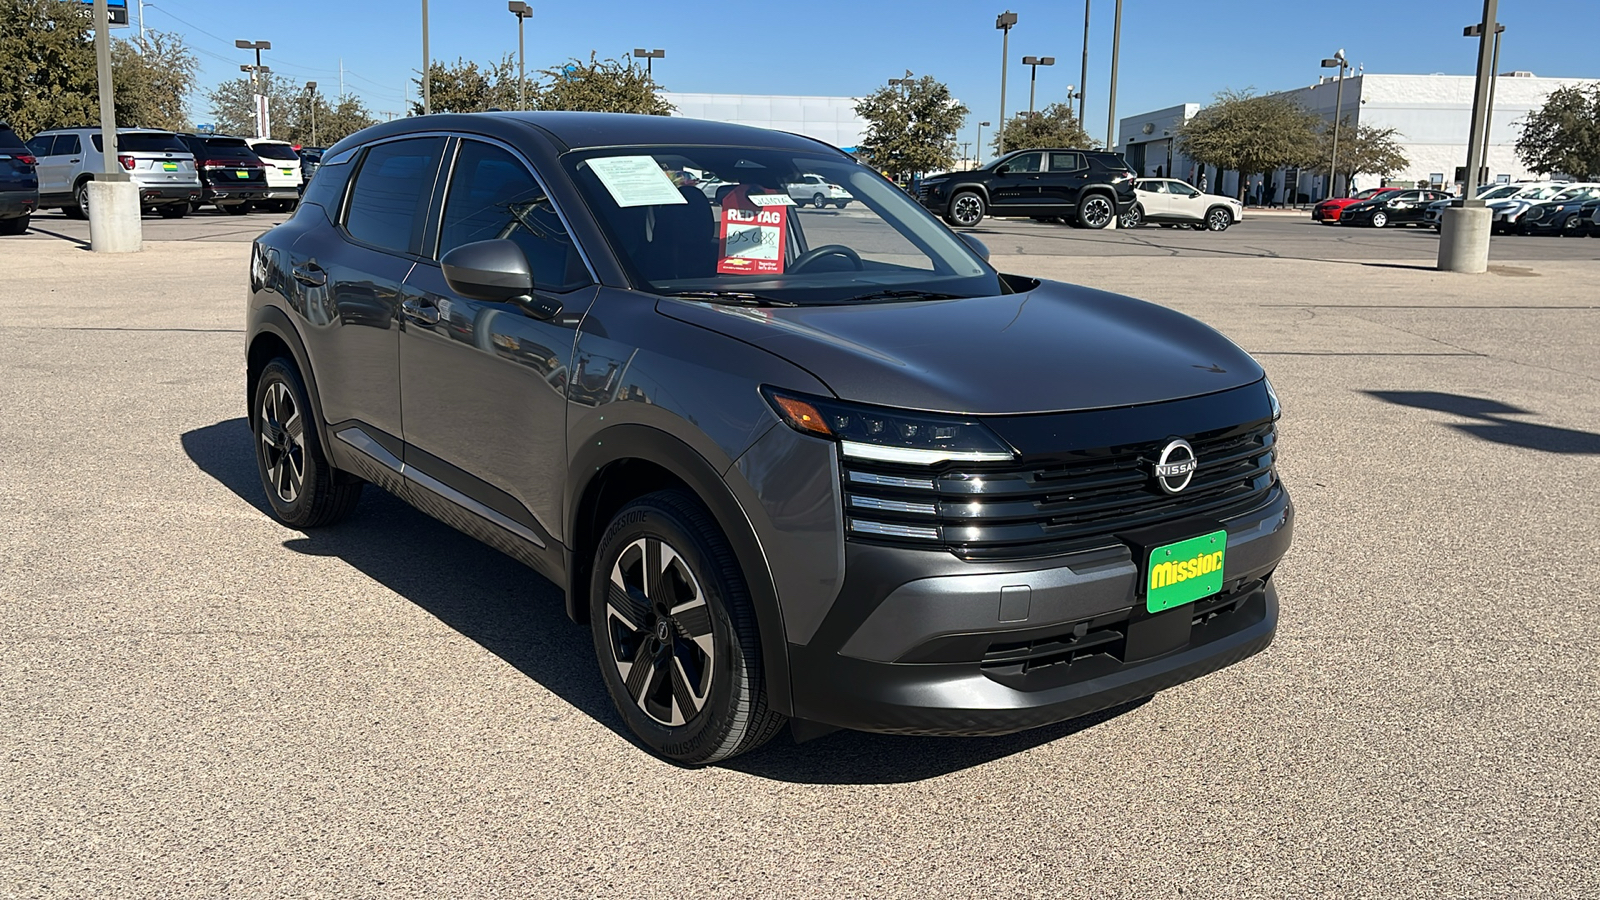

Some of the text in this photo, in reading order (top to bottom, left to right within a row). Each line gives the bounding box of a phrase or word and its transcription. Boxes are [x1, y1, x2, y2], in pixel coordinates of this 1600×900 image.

[727, 209, 780, 223] RED TAG
[1156, 459, 1197, 475] NISSAN
[599, 510, 647, 561] BRIDGESTONE
